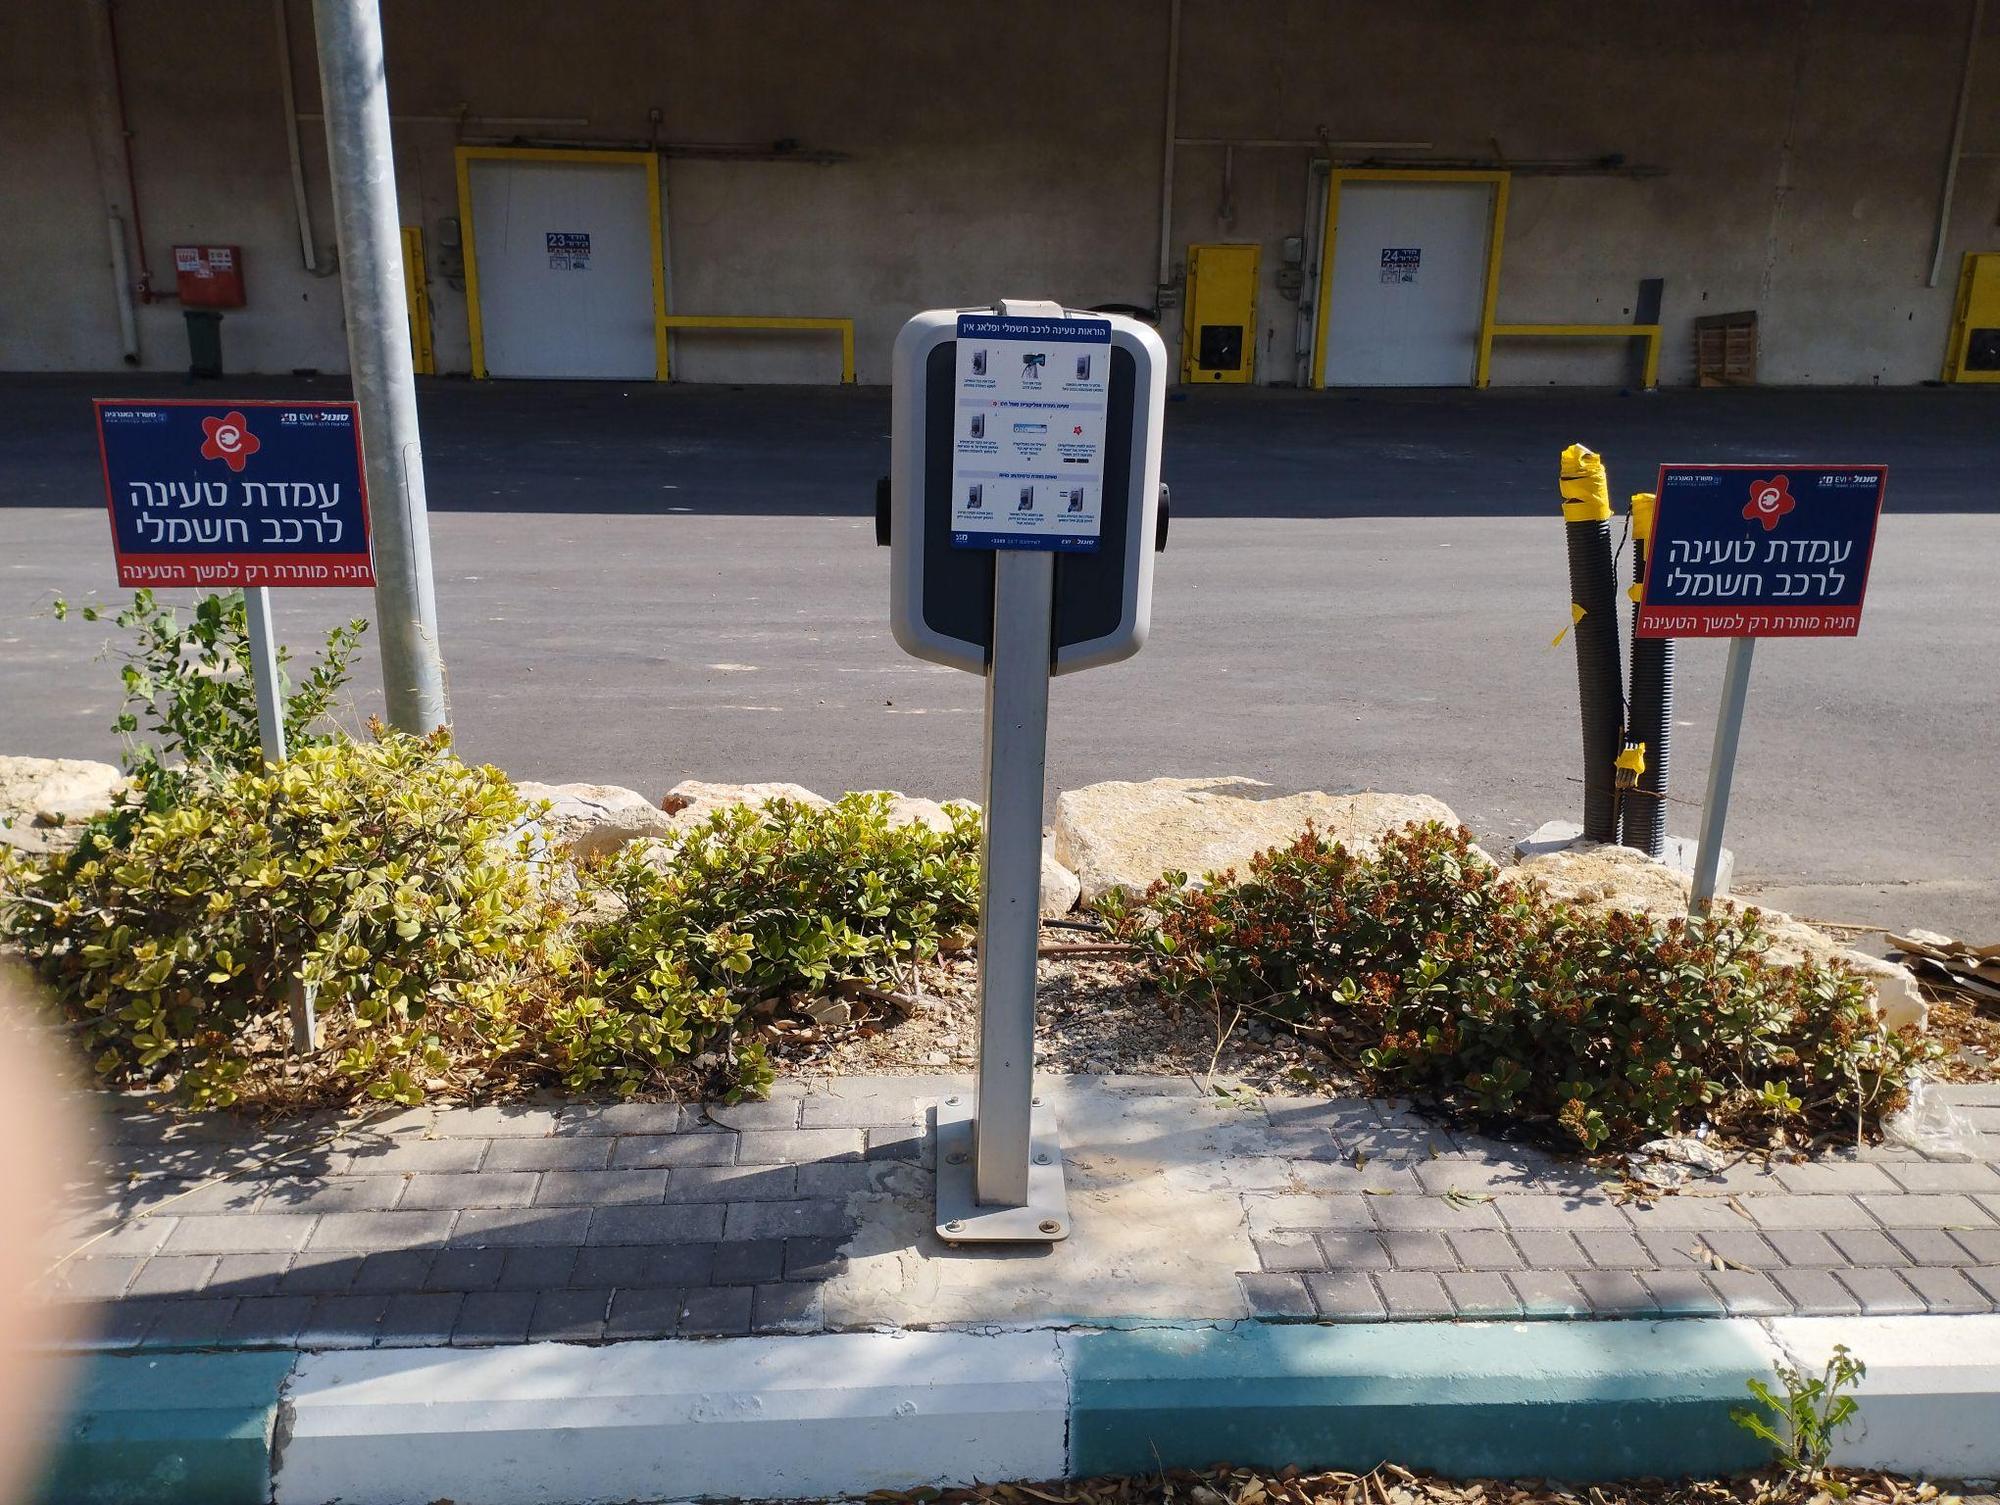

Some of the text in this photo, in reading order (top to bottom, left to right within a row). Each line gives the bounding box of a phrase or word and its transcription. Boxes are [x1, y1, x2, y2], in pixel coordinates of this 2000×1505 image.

[550, 234, 566, 246] 23
[1383, 250, 1398, 262] 24
[963, 322, 1106, 336] הוראות טעינה לרכב חשמלי ופלאג אין
[320, 412, 350, 421] סונול
[128, 482, 340, 508] עמדת טעינה
[136, 512, 343, 543] לרכב חשמלי
[1668, 540, 1852, 565] עמדת טעינה
[122, 562, 369, 582] חניה מותרת רק למשך הטעינה
[1666, 567, 1846, 596] לרכב חשמלי
[1642, 614, 1855, 632] חניה מותרת רק למשך הטעינה
